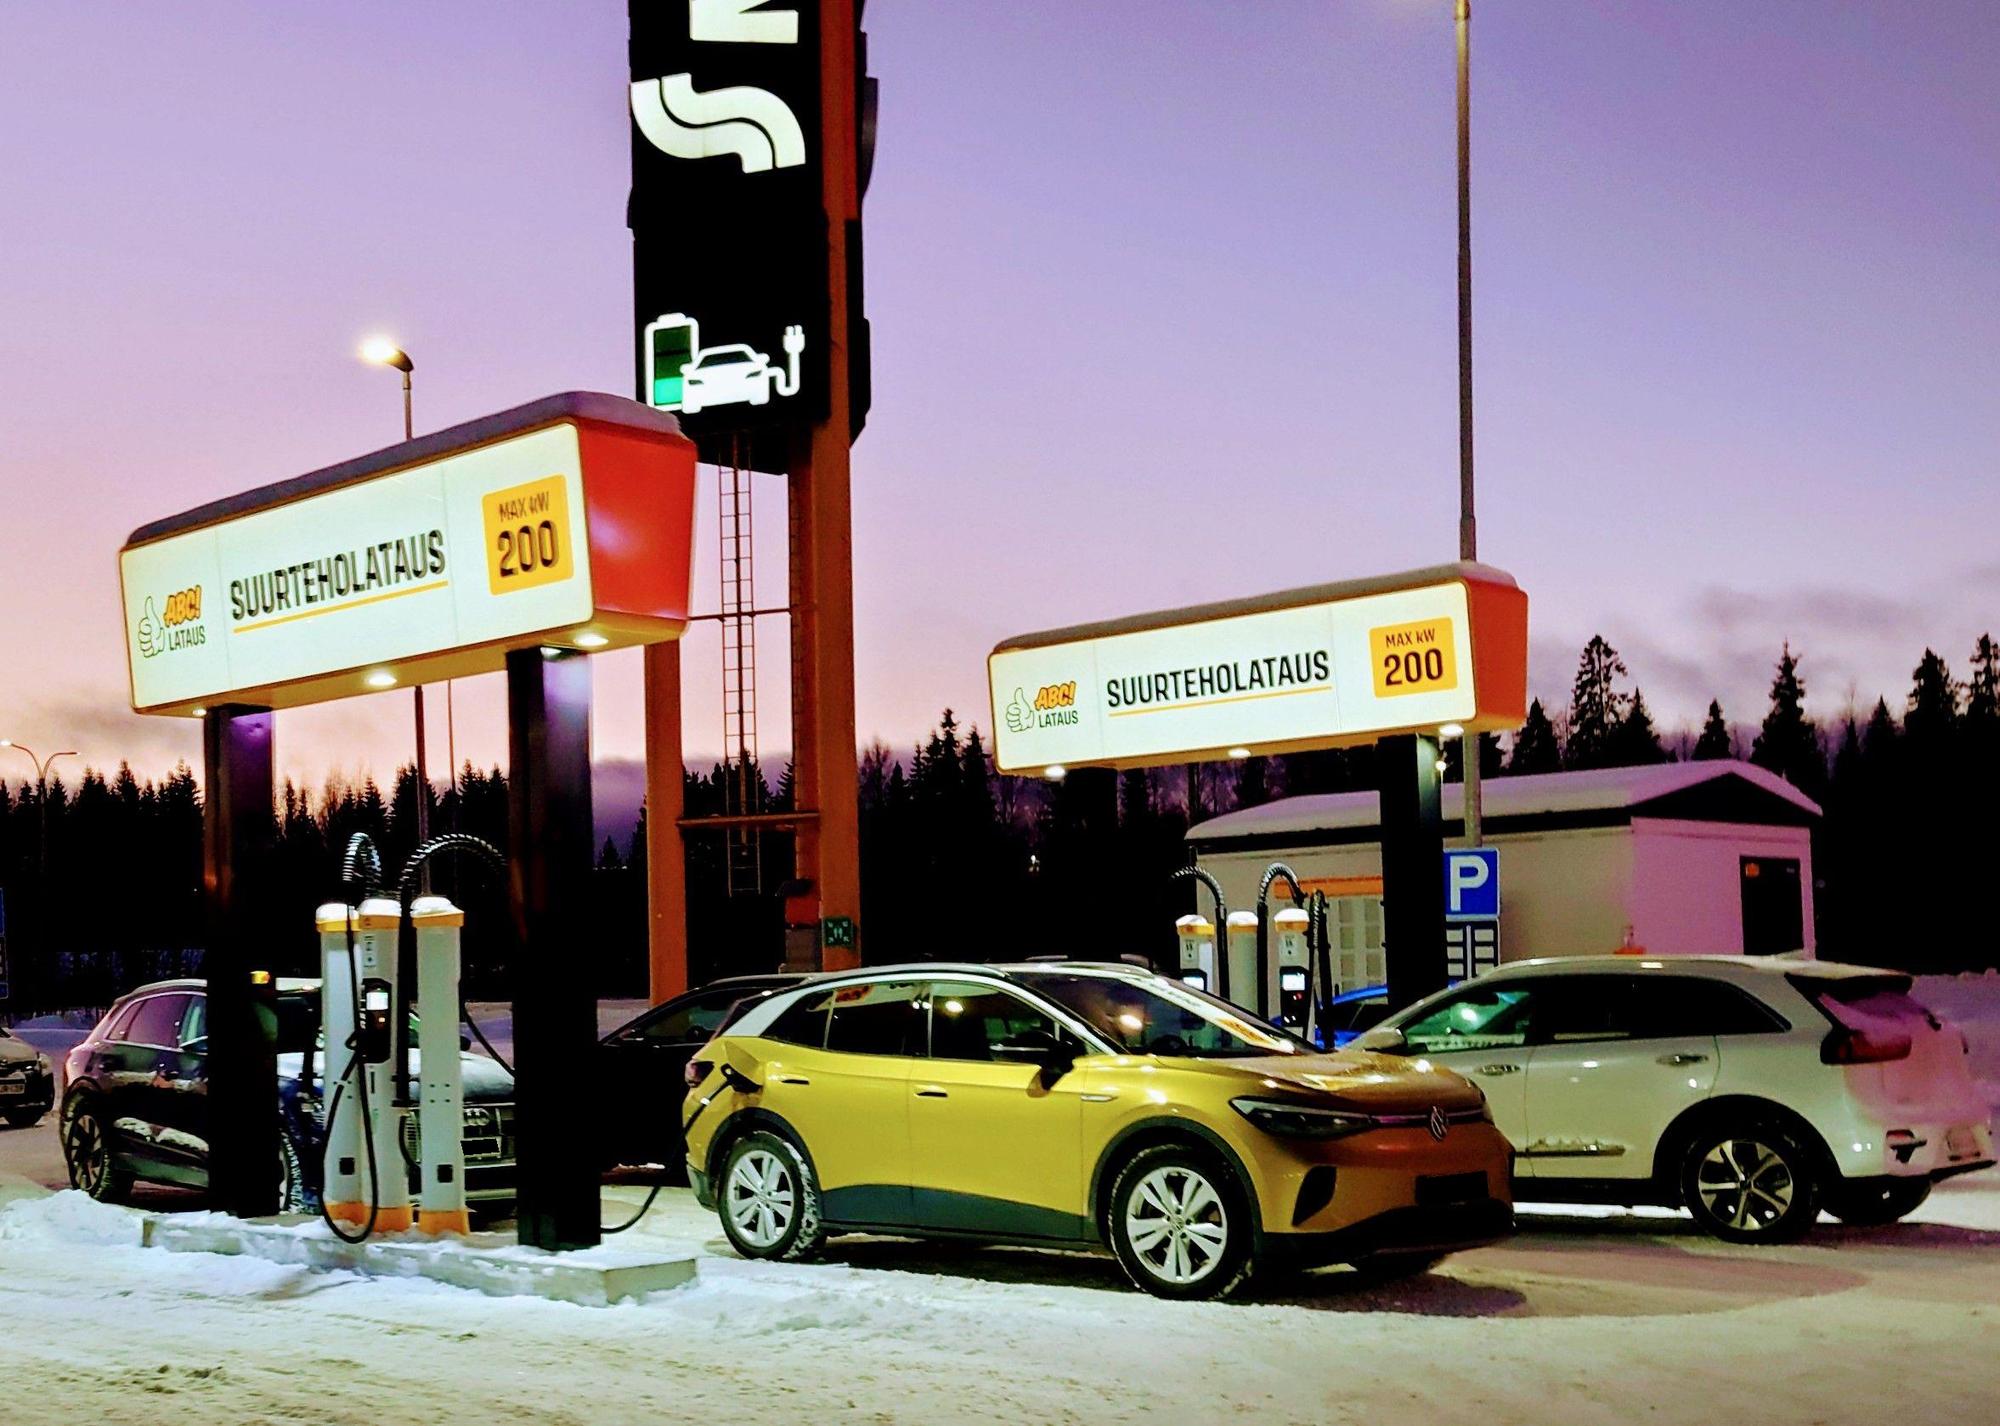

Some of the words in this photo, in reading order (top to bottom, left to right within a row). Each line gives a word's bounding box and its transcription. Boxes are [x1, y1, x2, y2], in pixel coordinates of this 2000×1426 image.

[499, 497, 527, 522] MAX
[497, 520, 560, 577] 200
[230, 529, 446, 621] SUURTEHOLATAUS
[163, 584, 202, 628] ABC!
[168, 625, 206, 651] LATAUS
[1385, 632, 1413, 648] MAX
[1416, 628, 1436, 644] kW
[1106, 650, 1330, 708] SUURTEHOLATAUS
[1384, 648, 1444, 686] 200
[1034, 680, 1076, 711] ABC!
[1038, 710, 1079, 728] LATAUS
[1450, 855, 1489, 912] P
